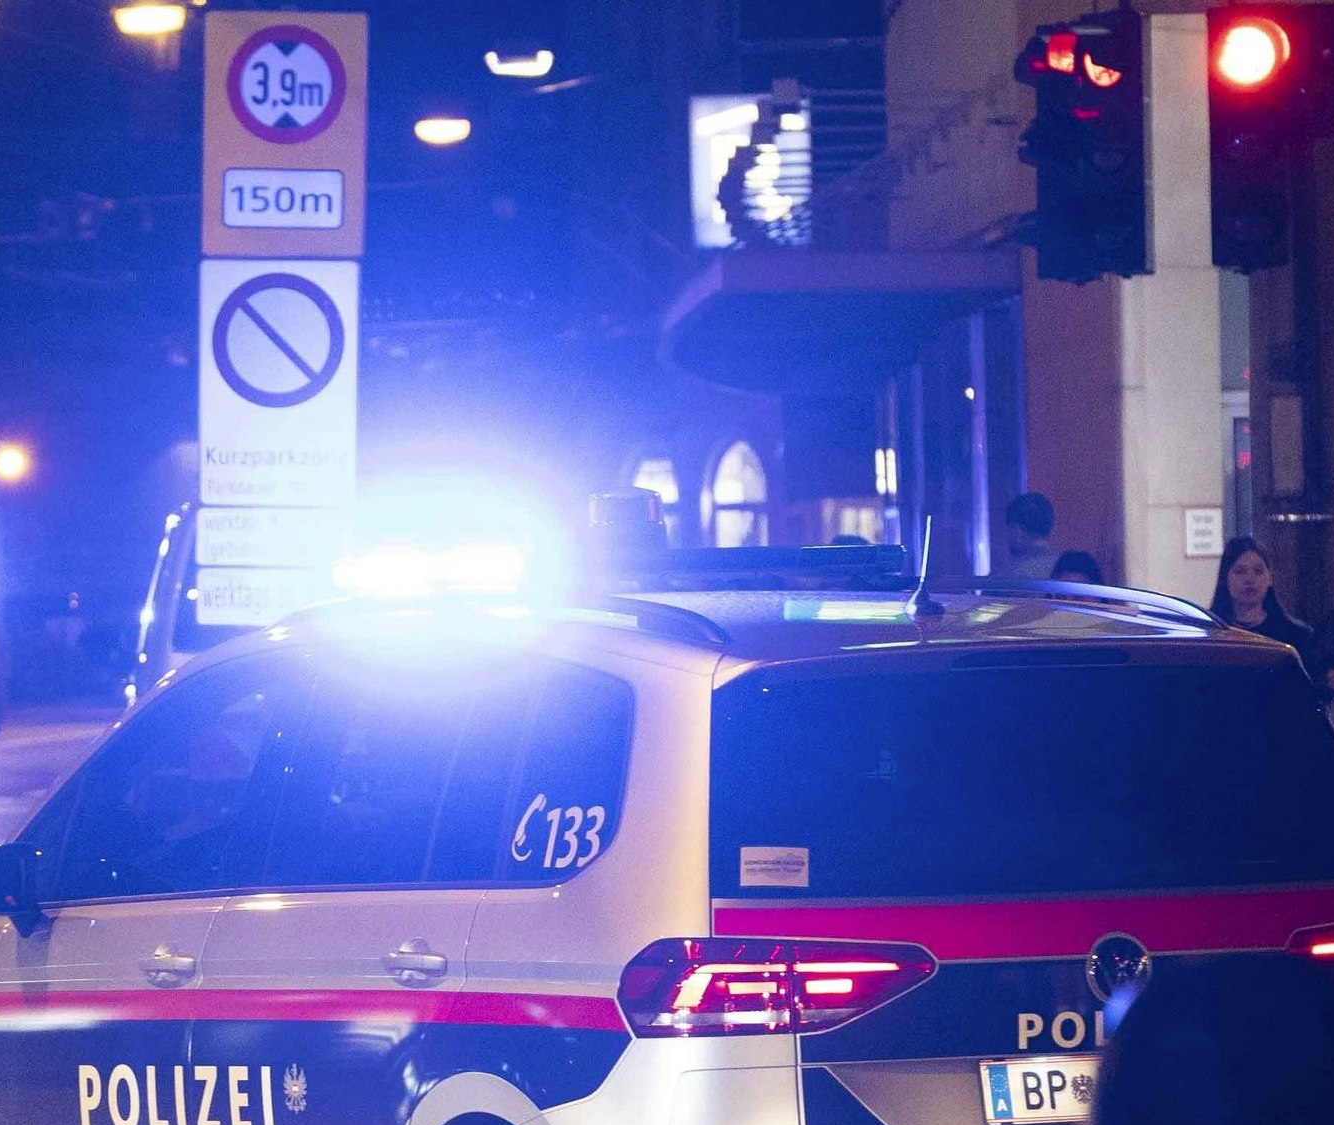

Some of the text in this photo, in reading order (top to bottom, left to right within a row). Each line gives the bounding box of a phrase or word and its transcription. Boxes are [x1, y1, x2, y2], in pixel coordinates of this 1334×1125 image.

[251, 60, 324, 107] 3,9m
[231, 186, 333, 213] 150m
[544, 805, 606, 869] 133
[1018, 1011, 1109, 1050] POL
[1022, 1070, 1067, 1110] BP
